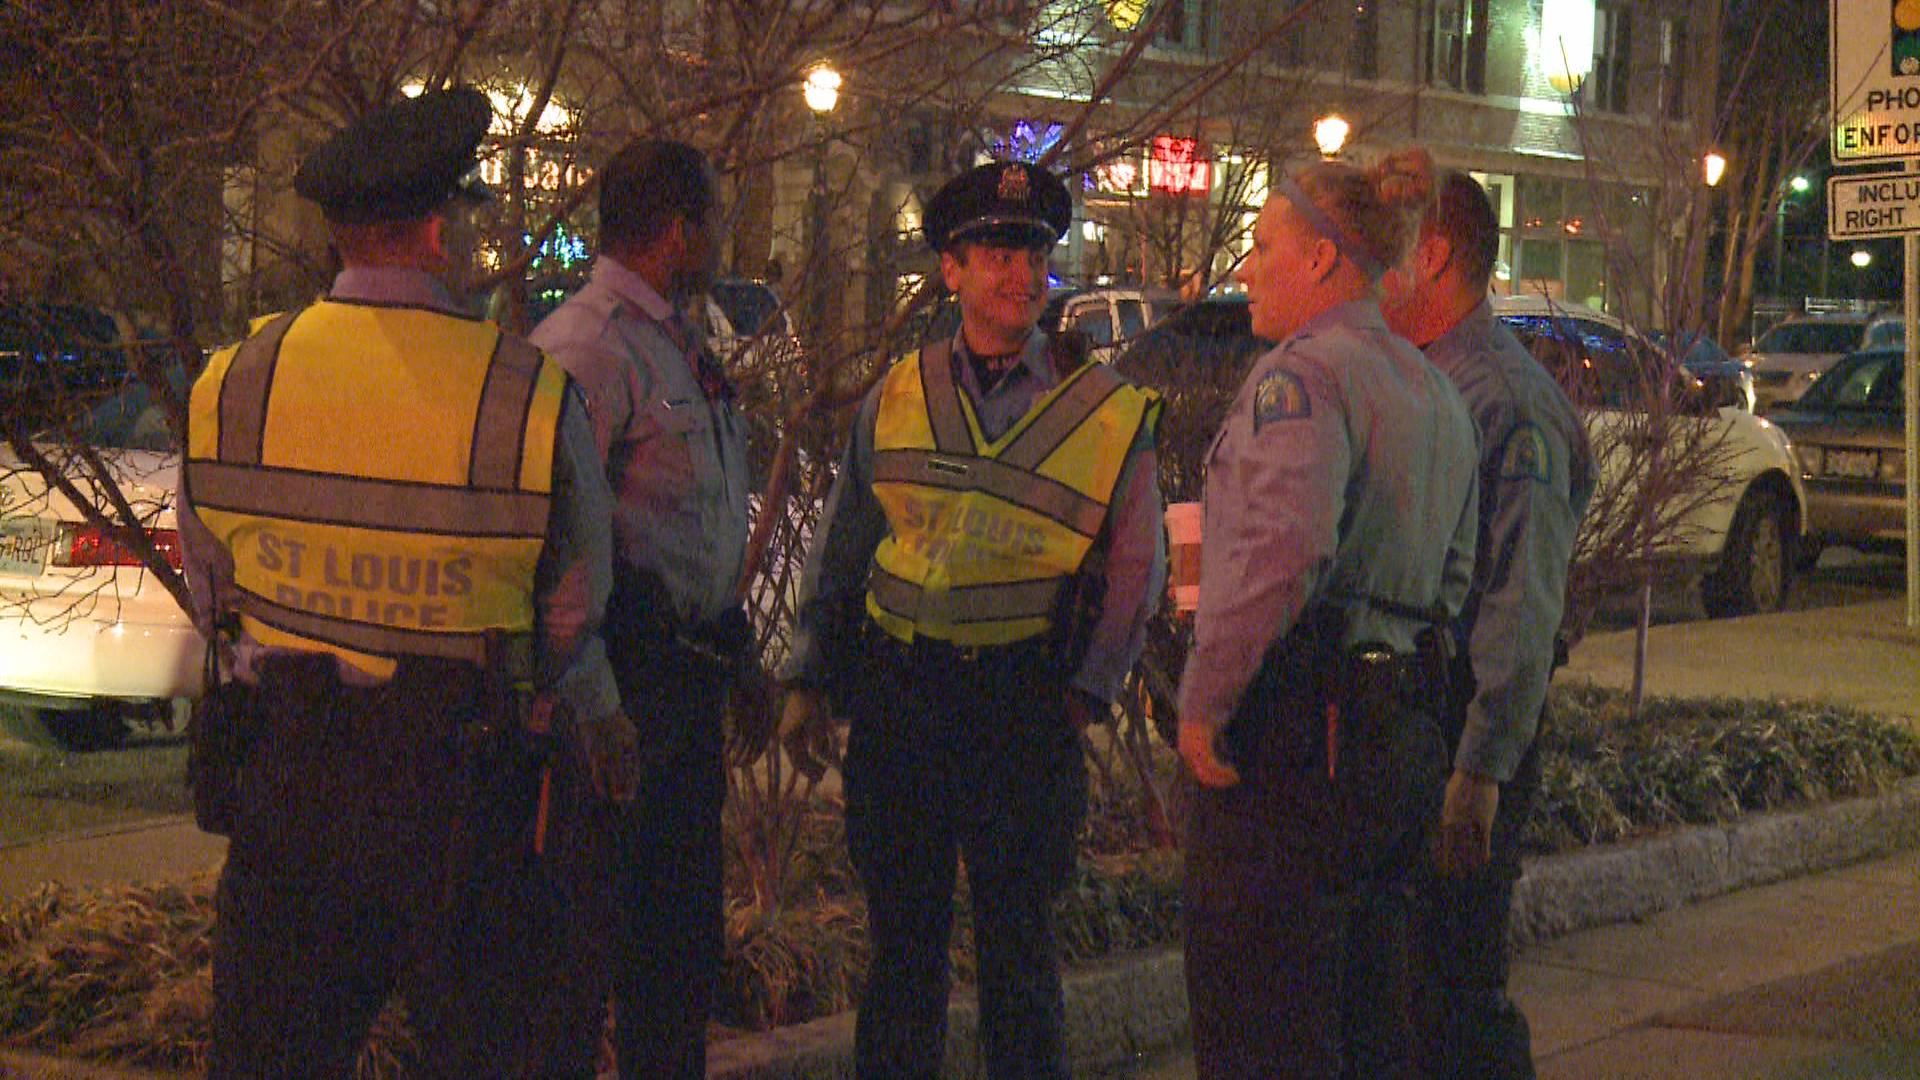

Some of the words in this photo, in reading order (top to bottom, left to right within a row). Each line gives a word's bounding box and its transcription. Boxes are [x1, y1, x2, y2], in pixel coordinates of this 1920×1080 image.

[1846, 207, 1905, 229] RIGHT
[256, 531, 306, 578] ST
[323, 544, 474, 597] LOUIS
